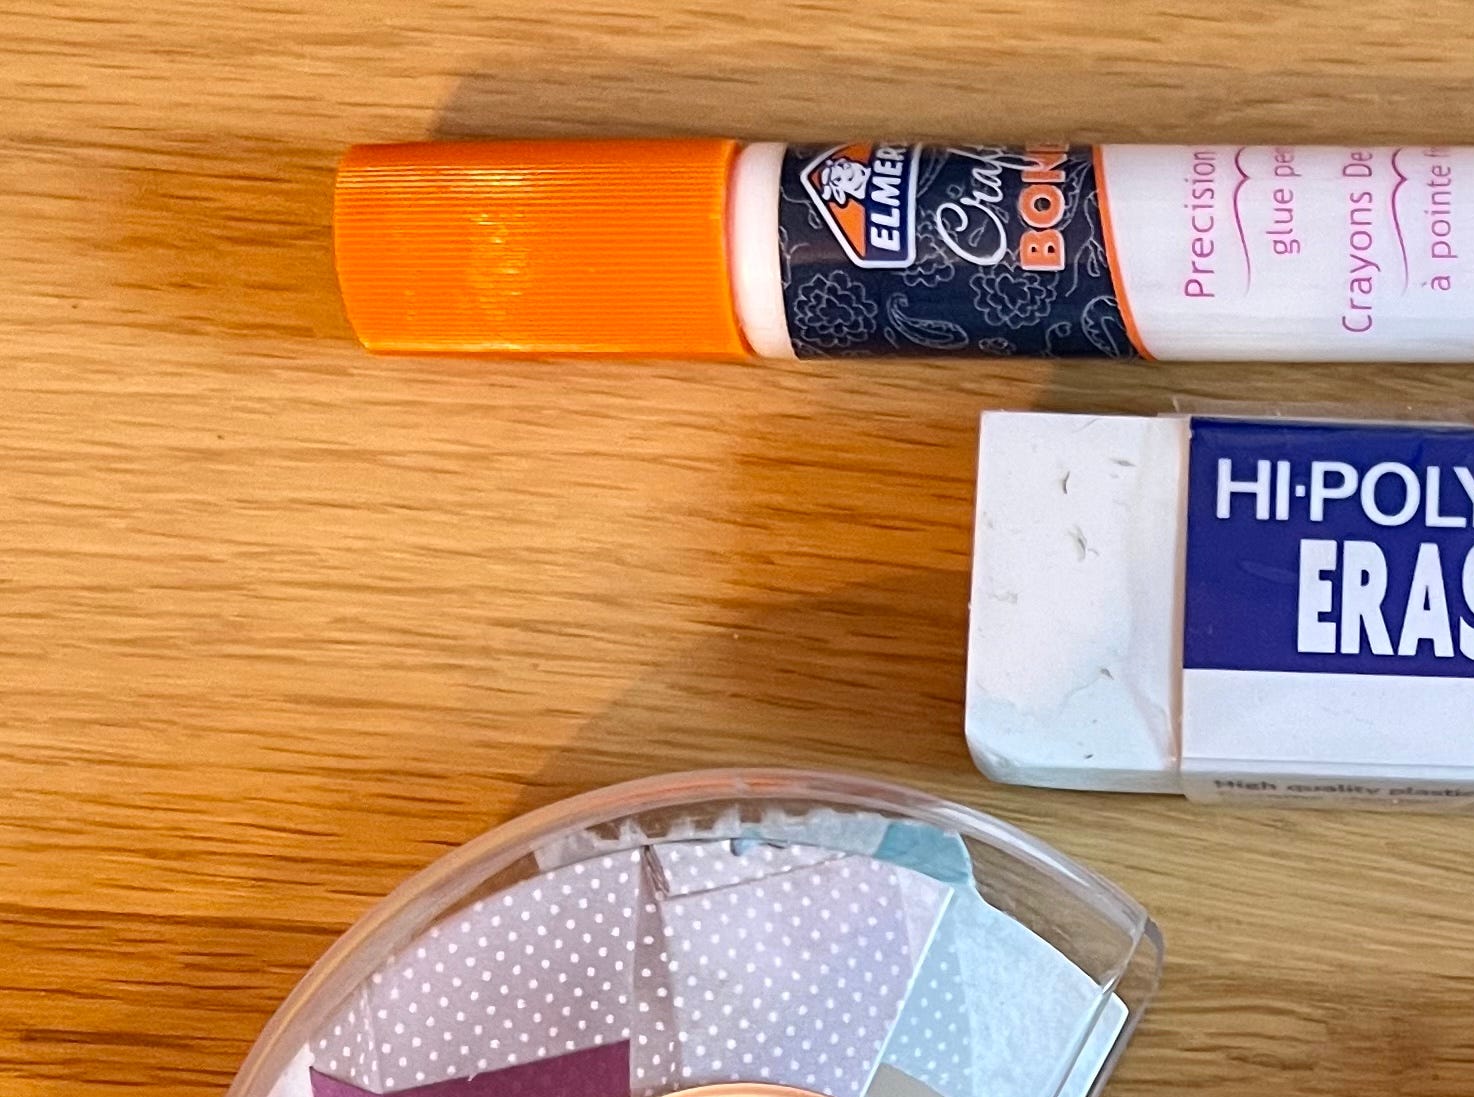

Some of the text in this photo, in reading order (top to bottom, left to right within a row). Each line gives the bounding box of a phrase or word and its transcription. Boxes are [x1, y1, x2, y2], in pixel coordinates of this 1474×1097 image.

[1184, 150, 1216, 298] Precision
[1266, 188, 1301, 256] glue
[1424, 165, 1458, 259] pointe
[1342, 191, 1381, 333] Crayons
[1422, 275, 1450, 292] à
